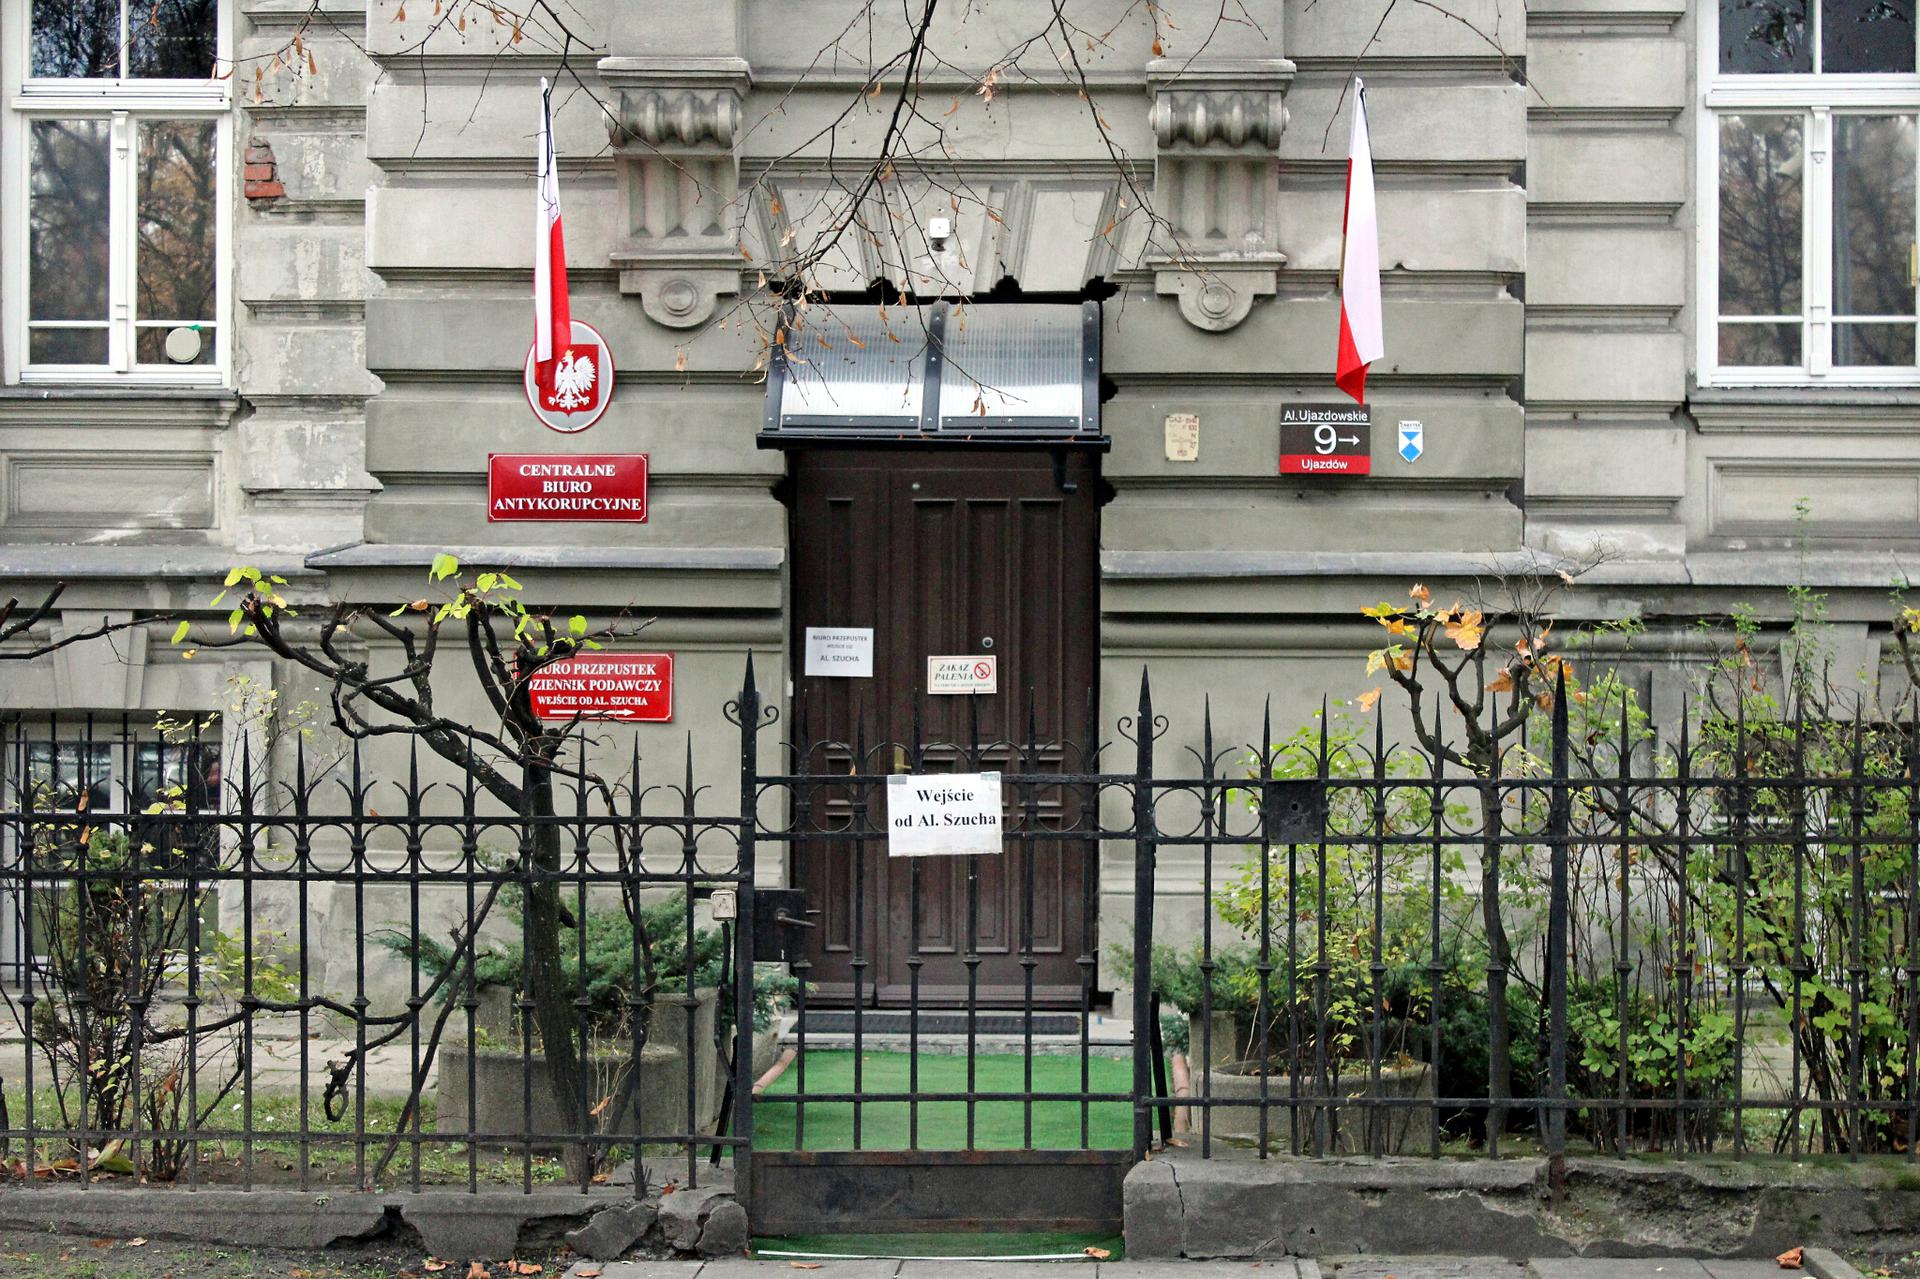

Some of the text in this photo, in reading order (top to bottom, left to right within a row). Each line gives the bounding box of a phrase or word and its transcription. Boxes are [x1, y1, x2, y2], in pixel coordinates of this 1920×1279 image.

[1284, 410, 1368, 423] Al. Ujazdowskie
[1314, 425, 1337, 455] 9
[519, 464, 616, 477] CENTRALNE
[1302, 459, 1348, 471] Ujazdów
[543, 481, 592, 493] BIURO
[494, 498, 642, 510] ANTYKORUPCYJNE
[574, 663, 656, 675] PRZEPUSTEK
[589, 679, 662, 692] PODAWCZY
[537, 694, 648, 706] WEJŚCIE OD AL. SZUCHA
[916, 789, 974, 805] Wejście
[895, 812, 997, 827] od Al. Szucha
